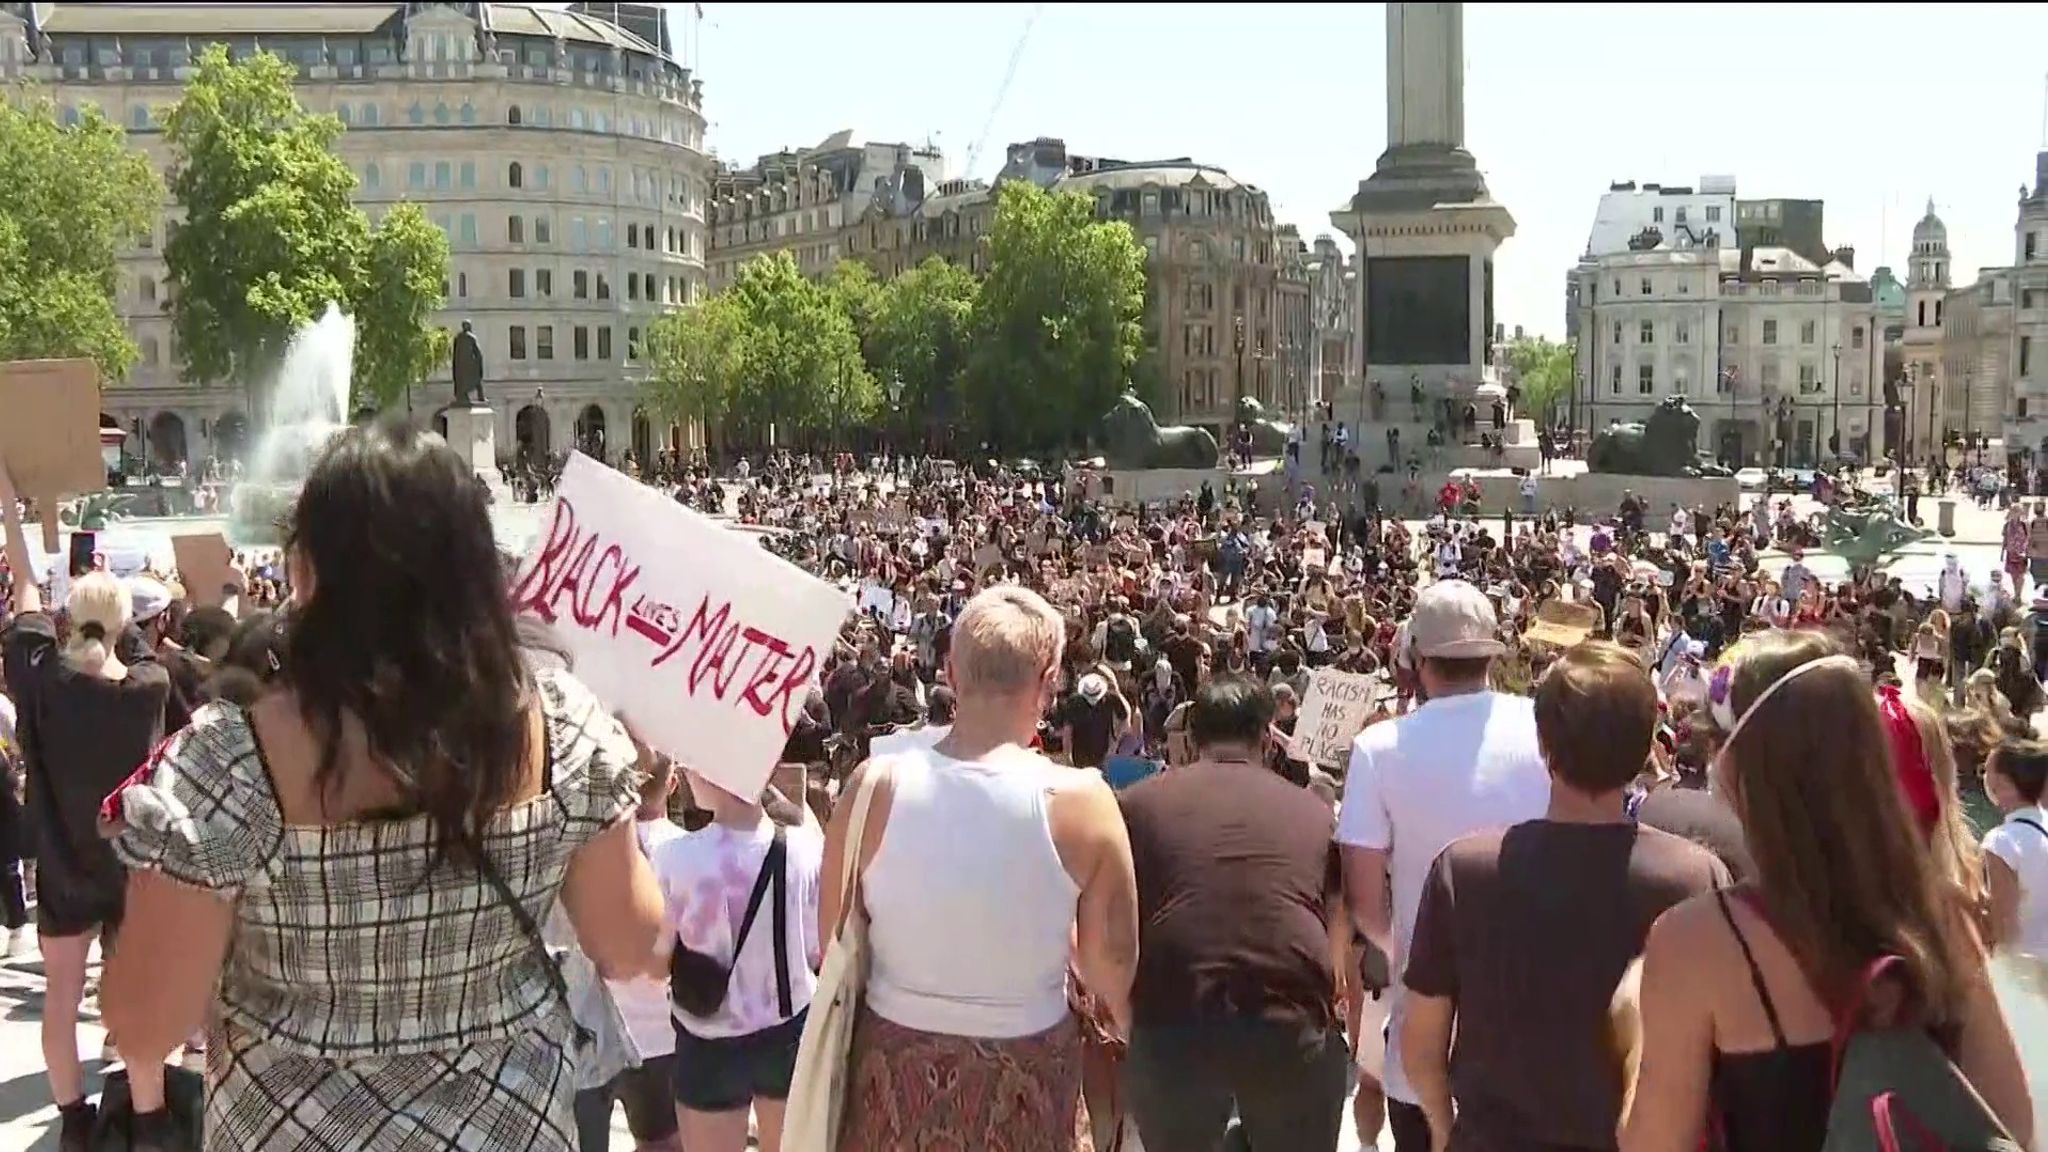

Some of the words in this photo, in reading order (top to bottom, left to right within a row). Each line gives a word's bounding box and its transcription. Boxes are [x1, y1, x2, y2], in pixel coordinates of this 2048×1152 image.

[514, 496, 641, 637] BLACK
[629, 594, 681, 634] LIVES
[651, 593, 815, 735] MATTER
[1317, 676, 1370, 703] RACISM
[1322, 703, 1346, 720] HAS
[1316, 722, 1339, 740] NO
